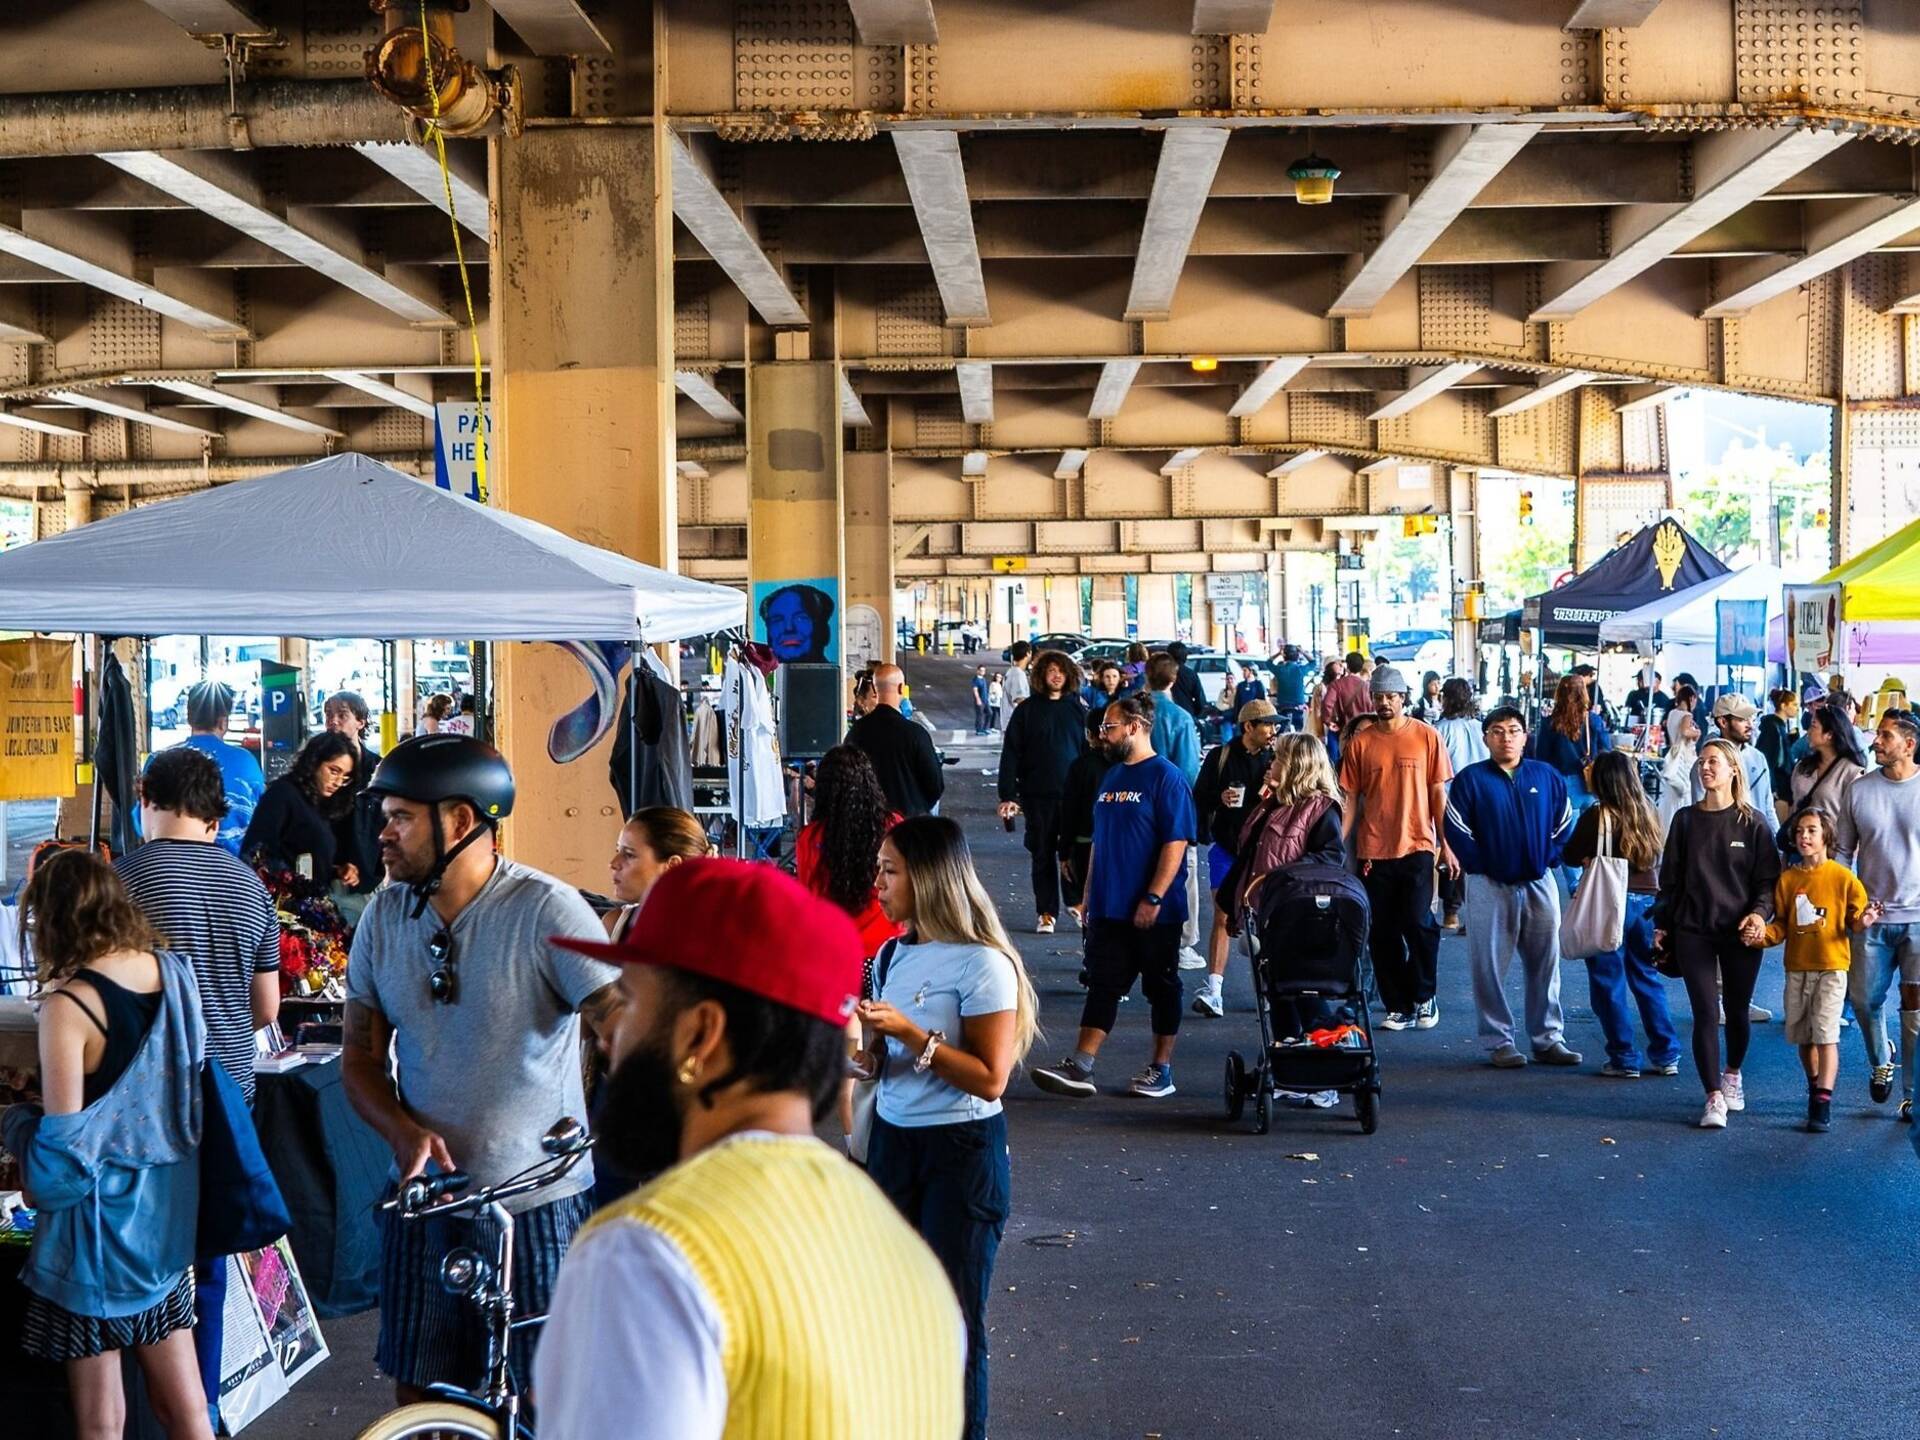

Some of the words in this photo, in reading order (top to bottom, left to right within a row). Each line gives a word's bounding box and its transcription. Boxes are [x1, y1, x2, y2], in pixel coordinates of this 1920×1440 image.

[458, 415, 491, 433] PAY
[1553, 607, 1612, 622] TRUFFLE
[271, 691, 286, 711] P
[53, 716, 71, 733] SAVE
[1115, 791, 1142, 803] YORK
